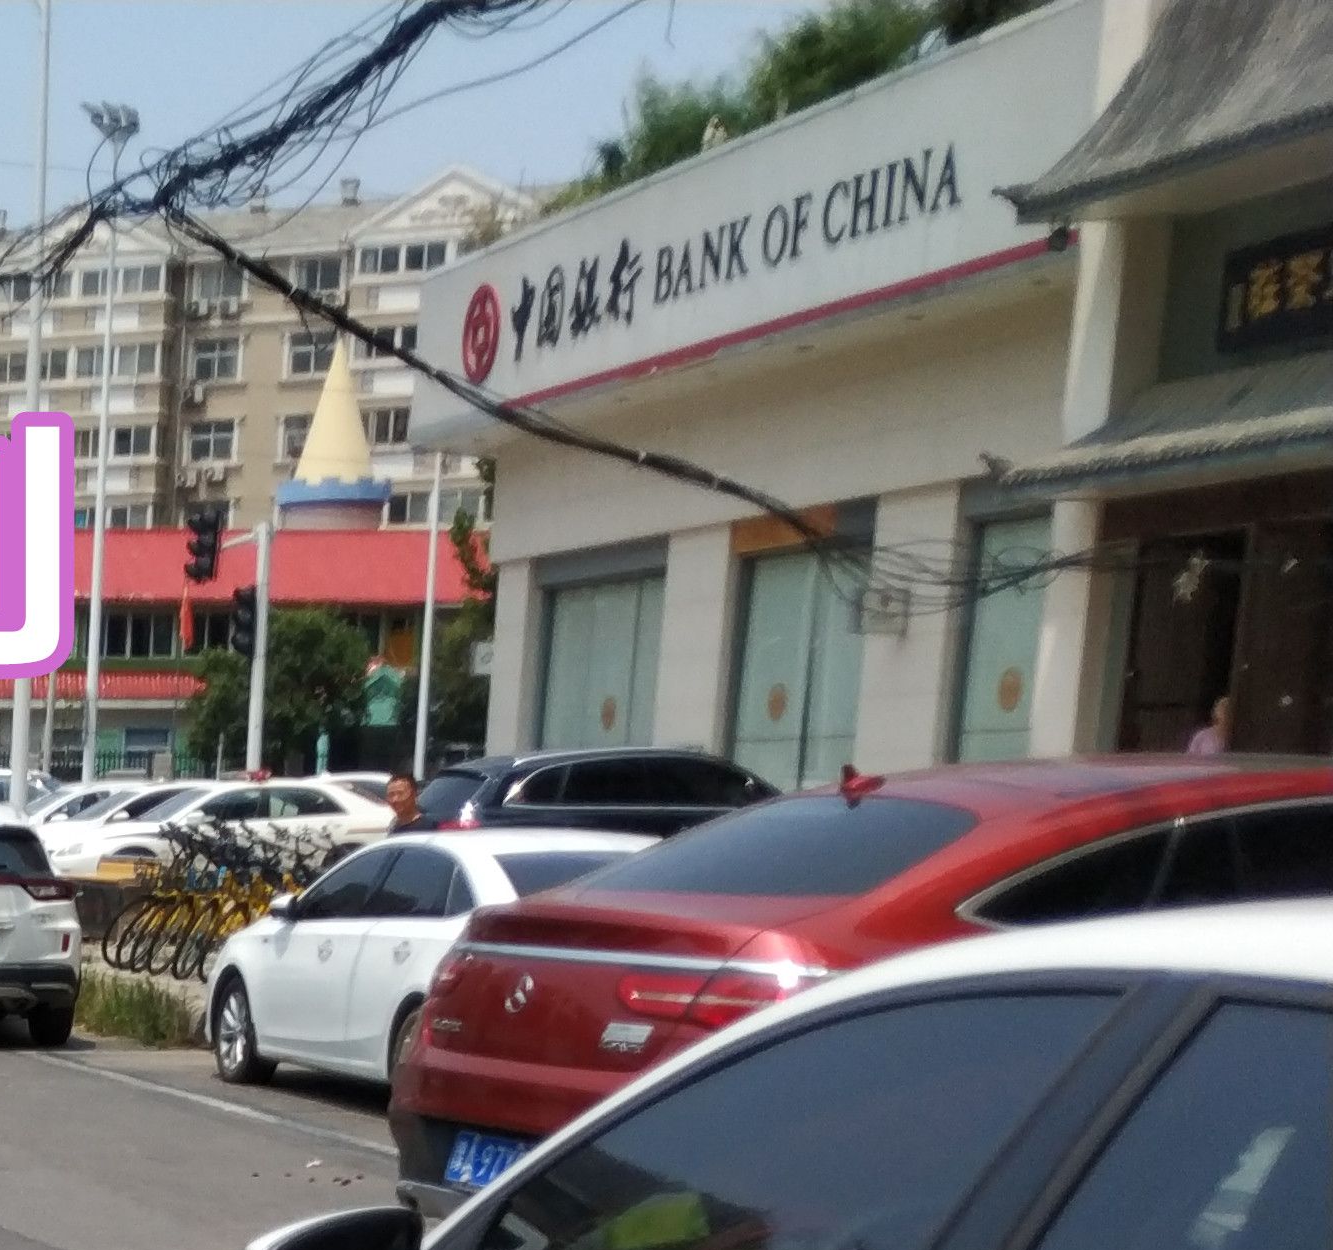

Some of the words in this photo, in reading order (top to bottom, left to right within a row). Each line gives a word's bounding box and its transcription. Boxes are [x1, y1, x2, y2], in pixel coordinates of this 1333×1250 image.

[653, 214, 749, 306] BANK
[761, 190, 813, 268] OF
[821, 141, 963, 248] CHINA
[510, 237, 645, 361] 中国银行
